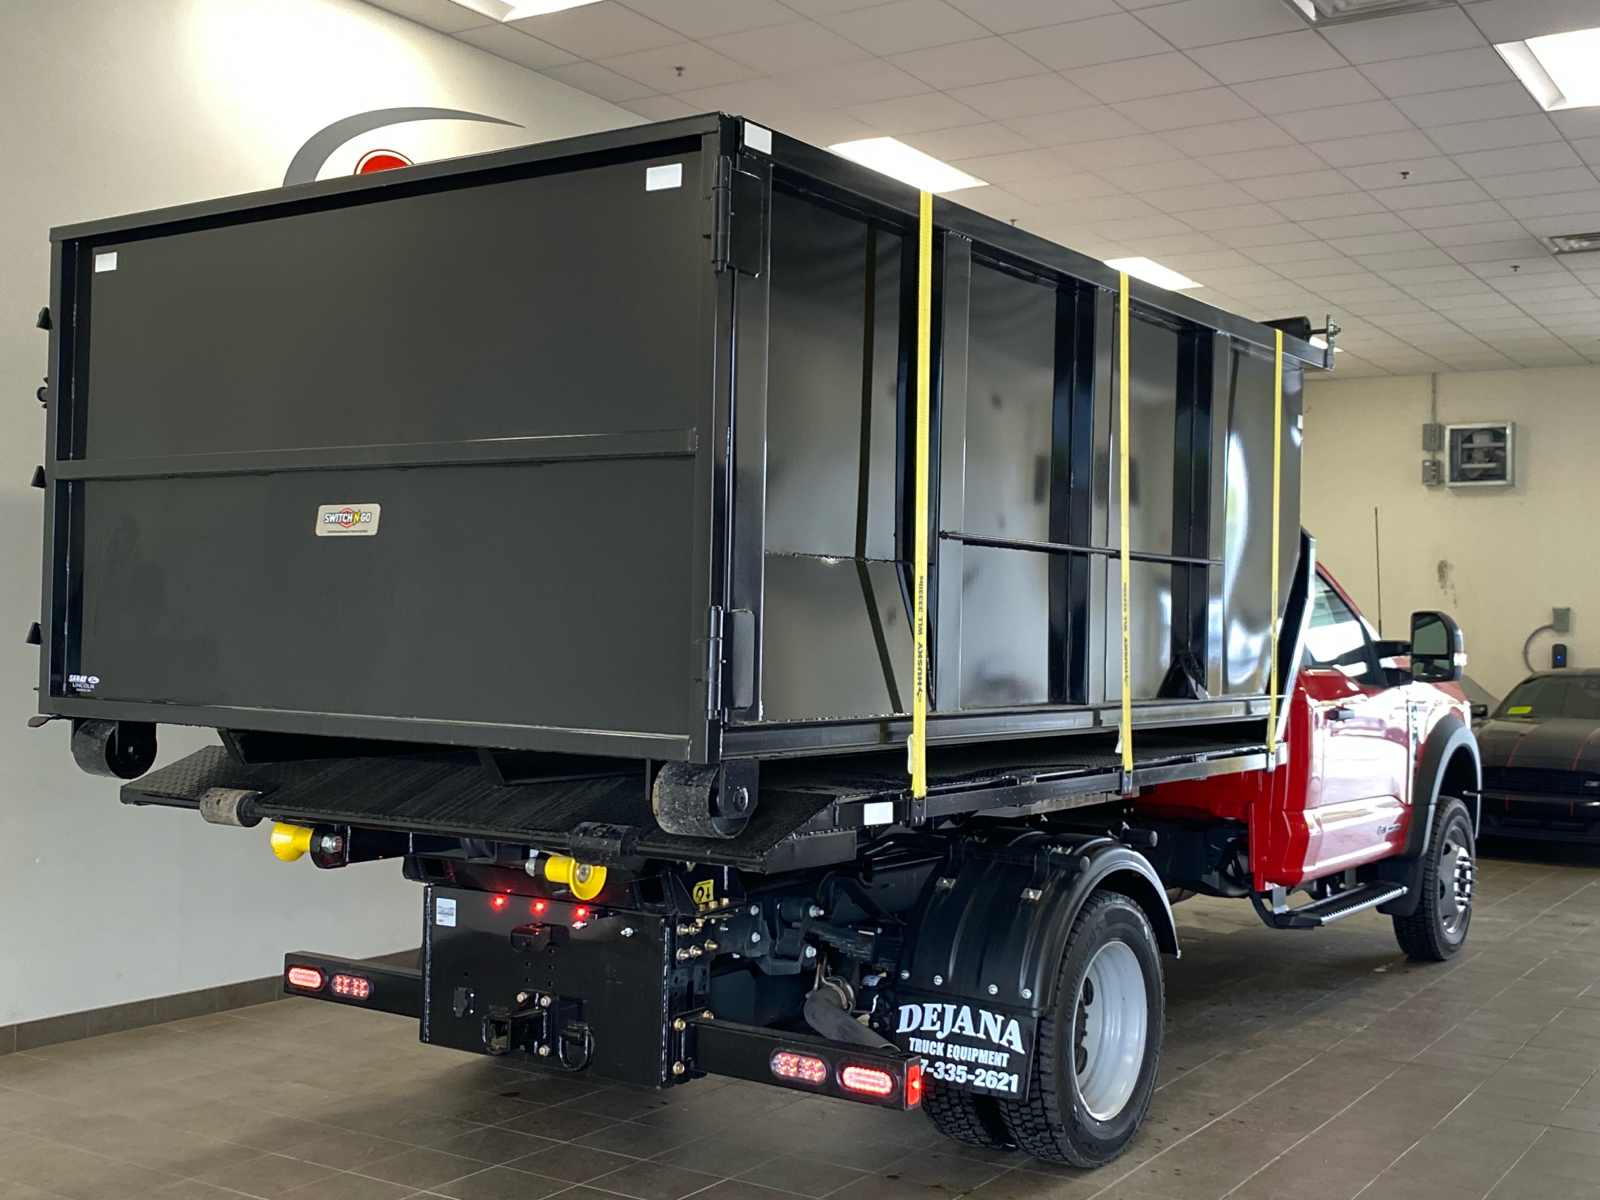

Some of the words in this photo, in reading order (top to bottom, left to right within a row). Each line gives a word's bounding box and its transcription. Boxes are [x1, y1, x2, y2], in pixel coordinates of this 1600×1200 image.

[896, 1003, 1026, 1054] DEJANA
[909, 1037, 946, 1057] TRUCK
[946, 1044, 1010, 1067] EQUIPMENT
